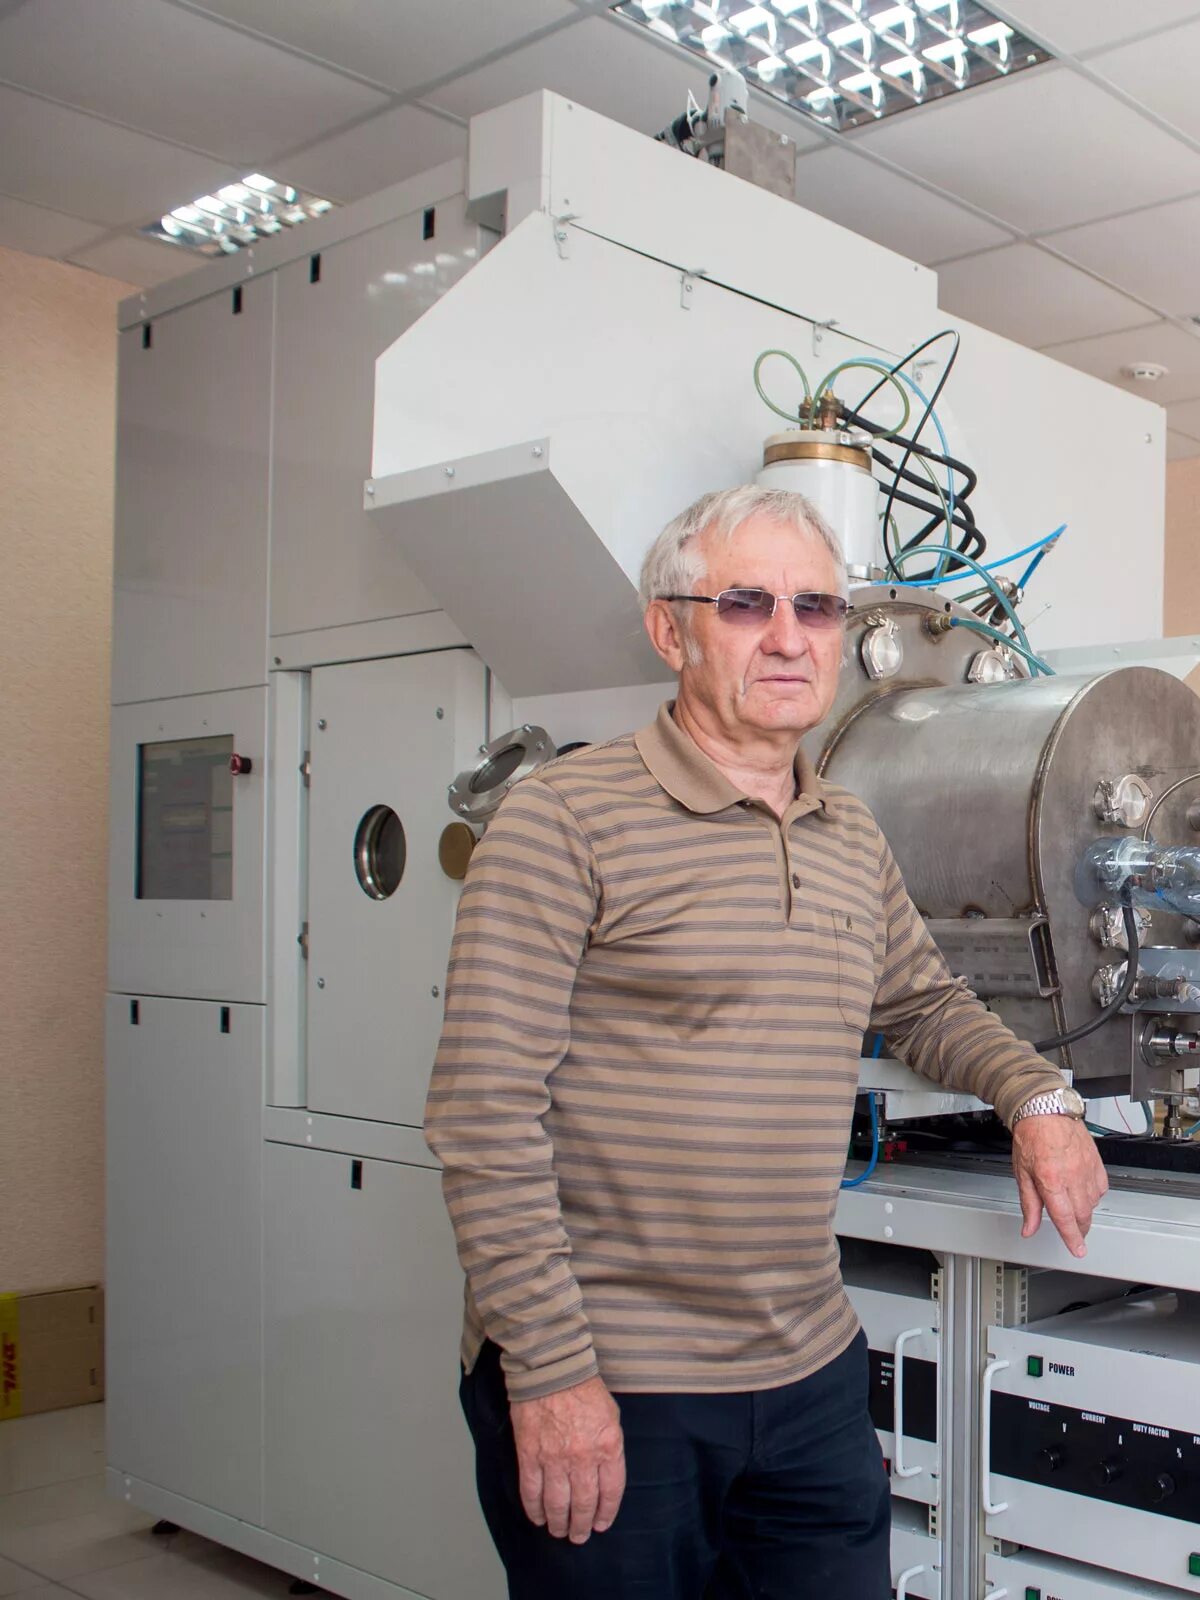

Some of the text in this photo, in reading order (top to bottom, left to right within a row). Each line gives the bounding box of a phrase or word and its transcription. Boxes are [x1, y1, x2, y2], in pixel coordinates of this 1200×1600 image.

[1048, 1362, 1075, 1377] POWER
[1028, 1401, 1050, 1413] VOLTAGE
[1081, 1412, 1106, 1424] CURRENT
[1062, 1422, 1067, 1433] V
[1132, 1423, 1170, 1439] DUTY FACTOR
[1118, 1434, 1123, 1445] A
[1176, 1447, 1182, 1459] %
